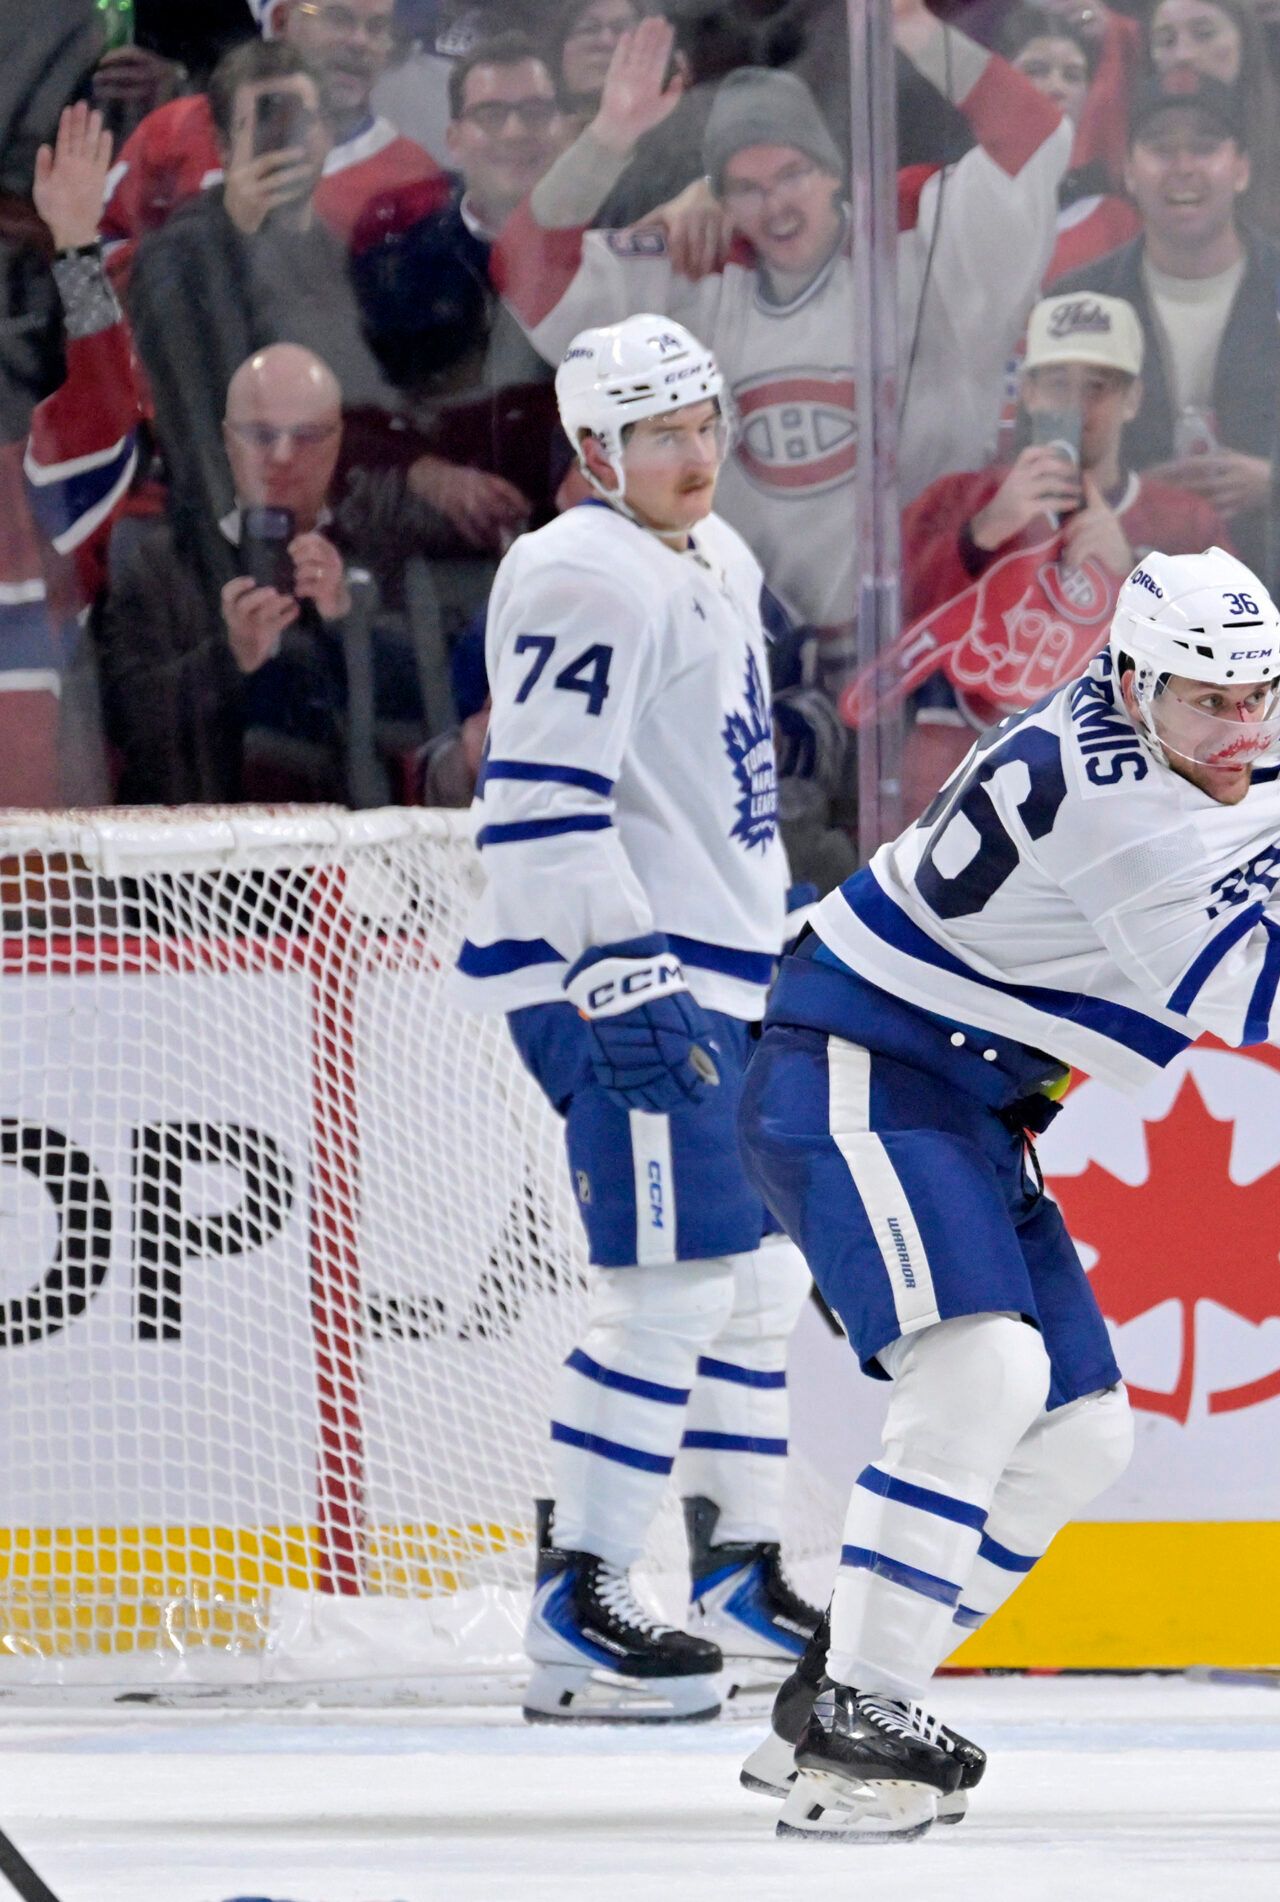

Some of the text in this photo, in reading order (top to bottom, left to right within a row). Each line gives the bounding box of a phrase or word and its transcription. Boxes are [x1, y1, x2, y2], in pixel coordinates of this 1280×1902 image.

[1131, 569, 1164, 599] OREO
[1222, 592, 1260, 616] 36
[513, 634, 614, 717] 74
[1230, 648, 1273, 661] CCM
[587, 966, 685, 1010] CCM
[647, 1160, 664, 1229] CCM
[886, 1217, 917, 1288] WARRIOR
